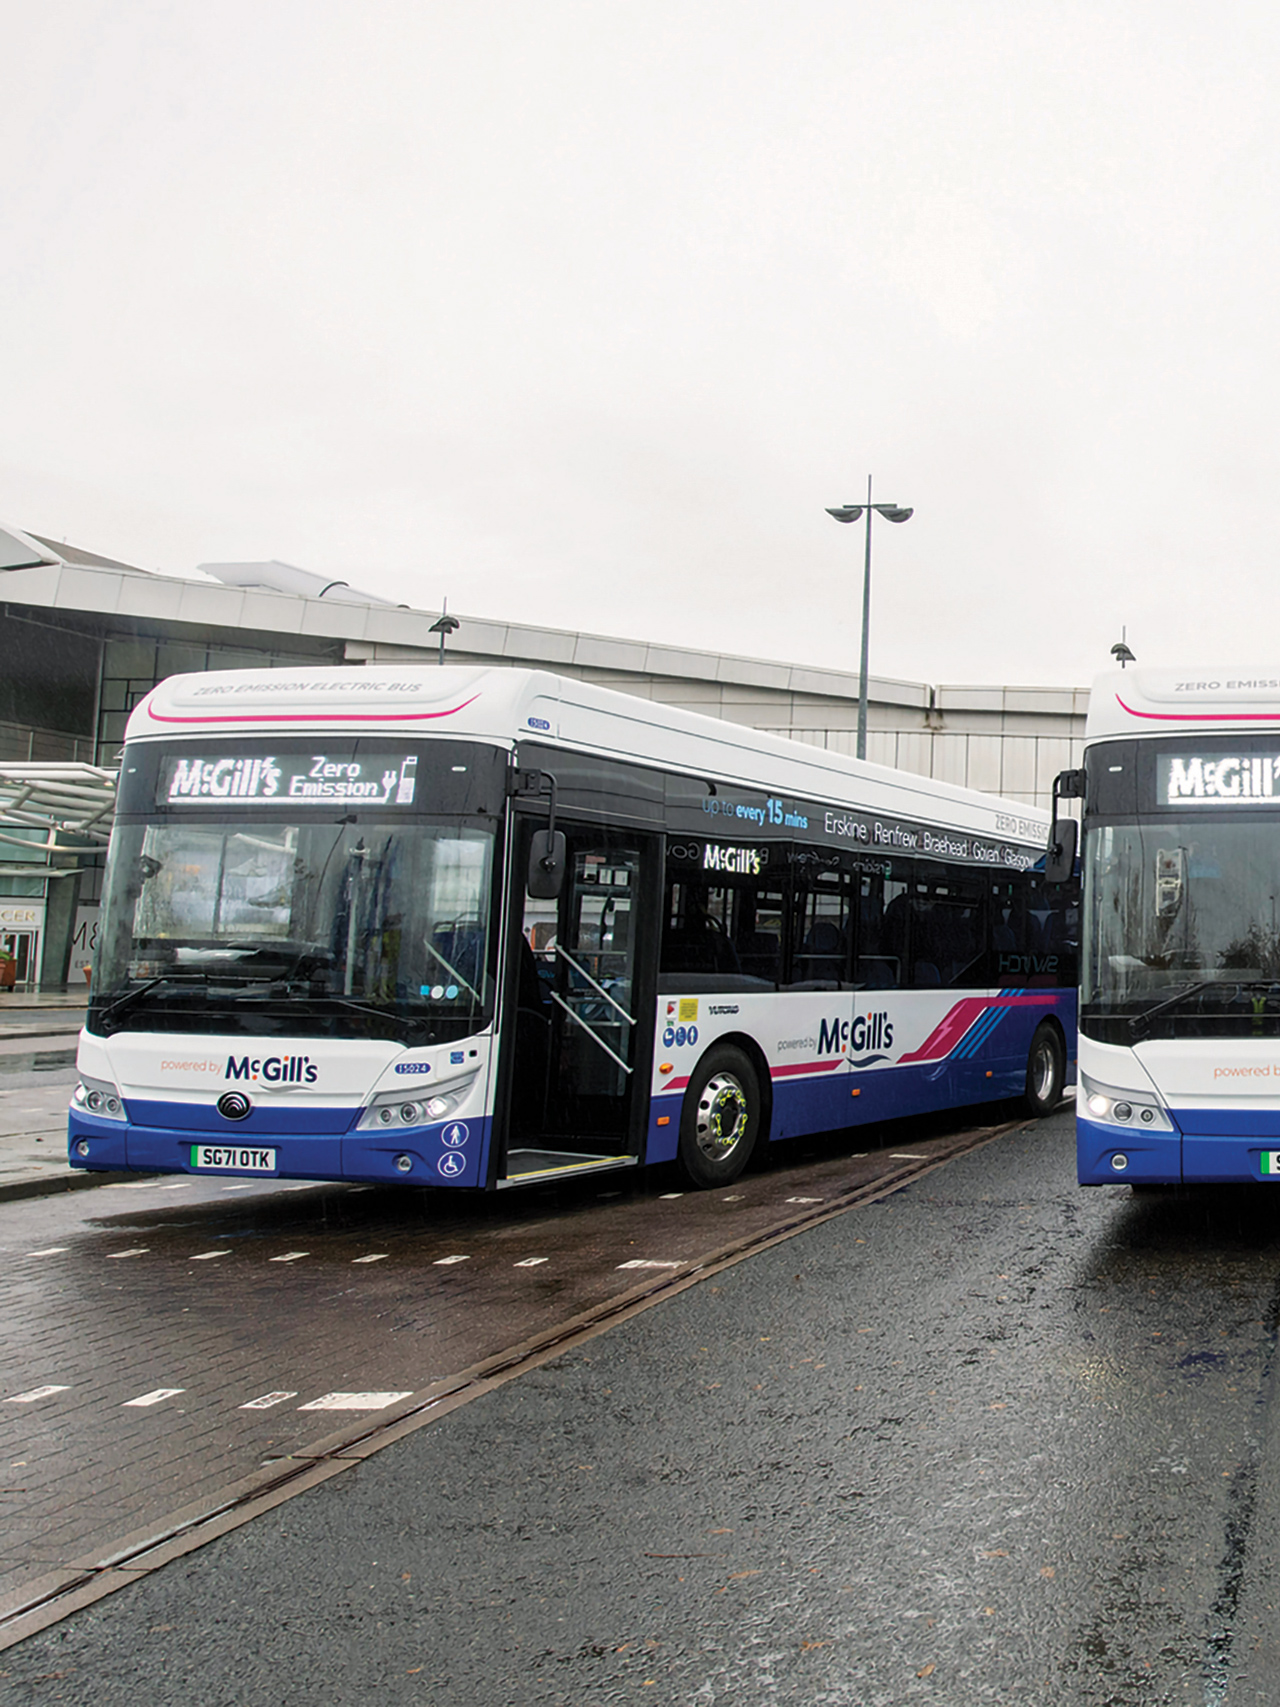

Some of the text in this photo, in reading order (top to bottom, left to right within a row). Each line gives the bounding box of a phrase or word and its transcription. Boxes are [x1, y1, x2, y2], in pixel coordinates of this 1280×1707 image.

[193, 681, 423, 696] ZERO EMISSION ELECTRIC BUS
[1174, 681, 1221, 692] ZERO
[170, 757, 282, 796] McGill's
[309, 756, 361, 778] Zero
[289, 776, 379, 796] Emission
[722, 801, 734, 816] to
[736, 804, 765, 826] every
[767, 798, 784, 825] 15
[785, 811, 808, 829] mins
[824, 812, 867, 839] Erskine
[874, 822, 918, 848] Renfrew
[923, 832, 967, 858] Braehead
[972, 843, 1000, 863] Govan
[995, 814, 1048, 840] ZERO EMISSIO
[703, 843, 761, 875] McGill's
[776, 1036, 807, 1053] powered
[817, 1011, 893, 1055] McGill's
[161, 1055, 318, 1083] powered by McGill's
[1214, 1064, 1270, 1080] powered
[203, 1149, 270, 1168] SG71 OTK
